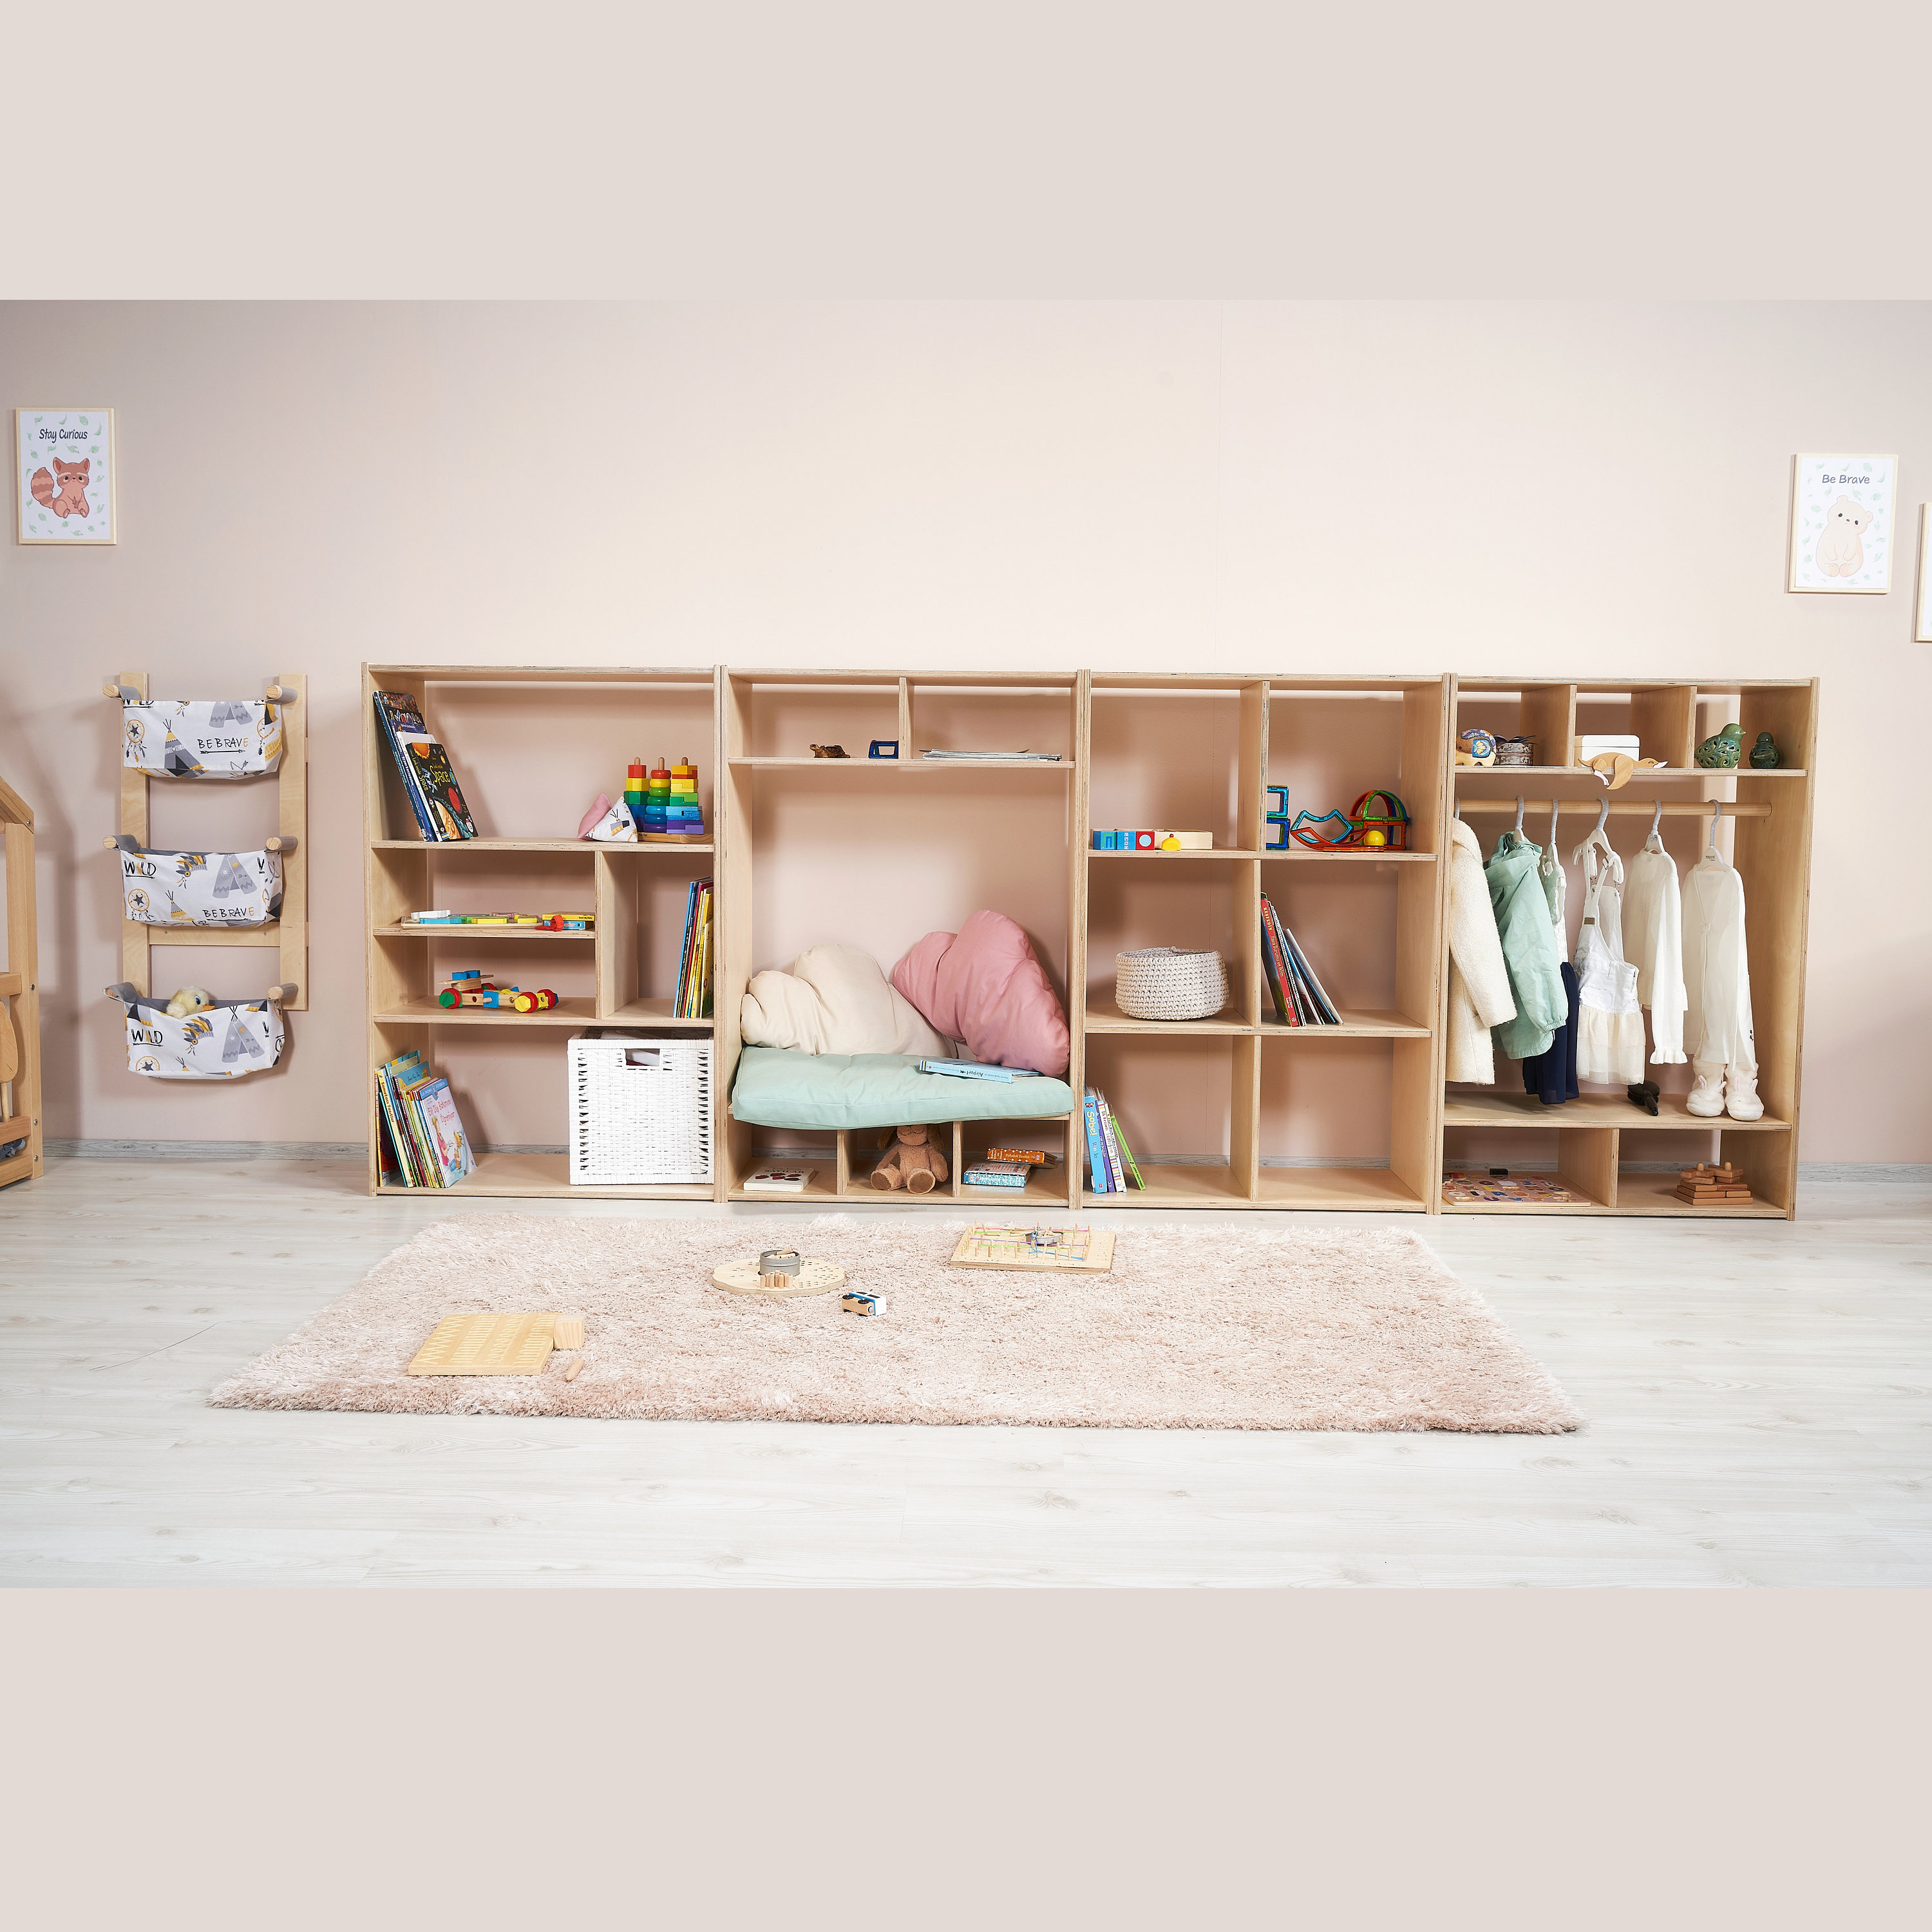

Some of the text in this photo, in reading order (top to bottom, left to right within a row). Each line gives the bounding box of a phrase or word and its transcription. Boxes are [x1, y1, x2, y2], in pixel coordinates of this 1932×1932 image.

[39, 428, 88, 443] Stay Curious
[1822, 474, 1870, 484] Be Brave
[197, 737, 249, 749] BE BRAVE
[419, 775, 429, 791] Space
[430, 765, 451, 786] Space
[202, 907, 254, 918] BE BRAVE
[1086, 1110, 1097, 1135] Sobe!
